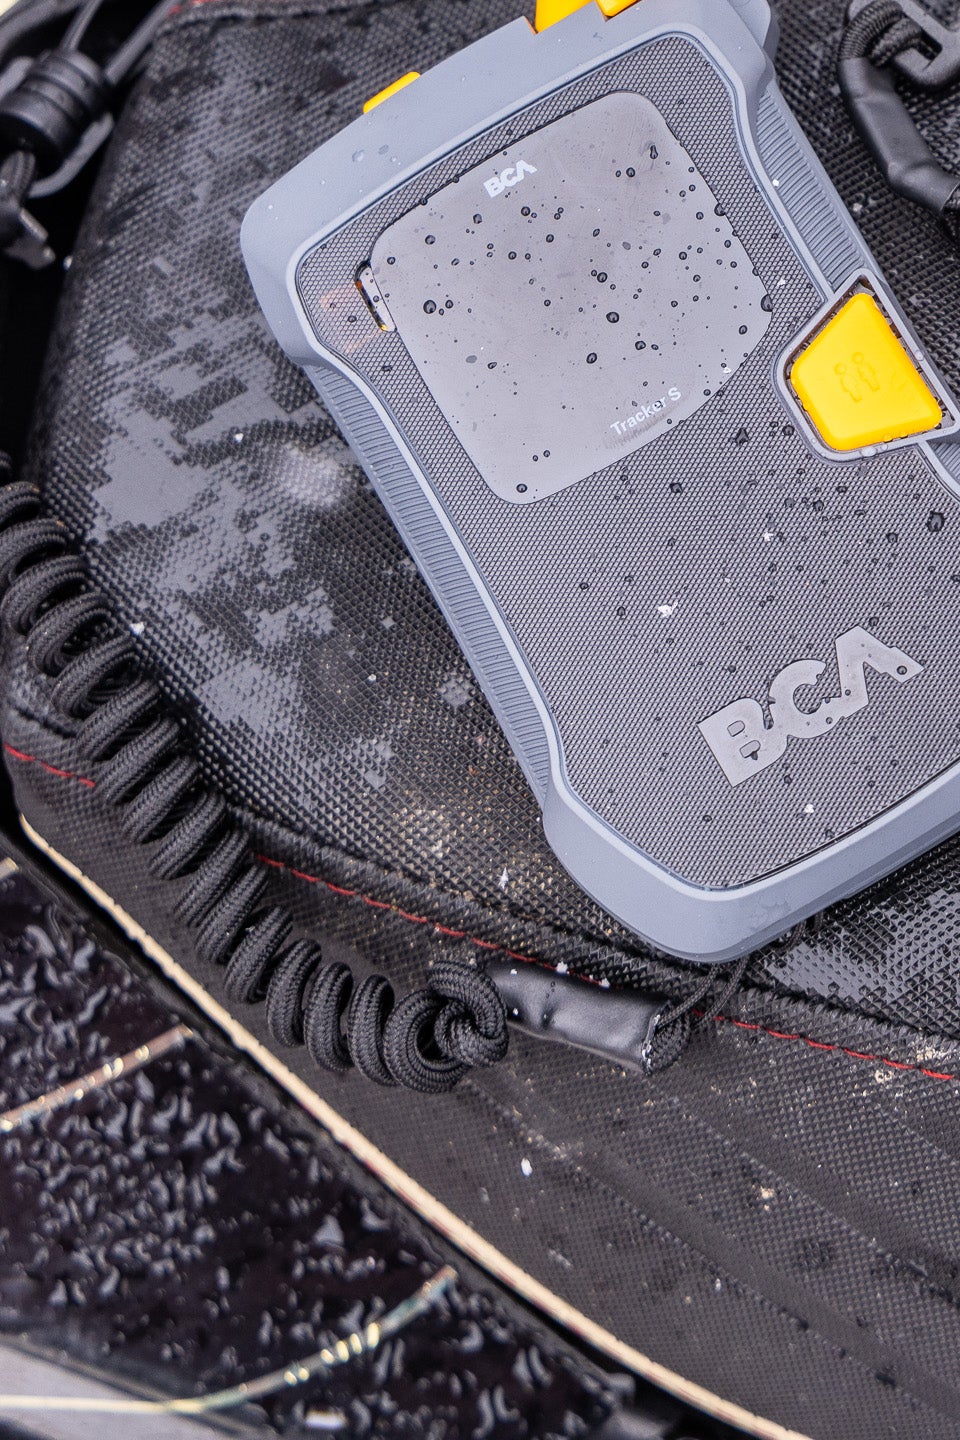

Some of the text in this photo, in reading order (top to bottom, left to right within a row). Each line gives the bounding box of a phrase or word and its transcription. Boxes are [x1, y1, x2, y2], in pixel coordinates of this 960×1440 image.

[482, 159, 538, 199] BCA
[609, 386, 682, 436] Tracker S
[696, 624, 926, 788] BCA
